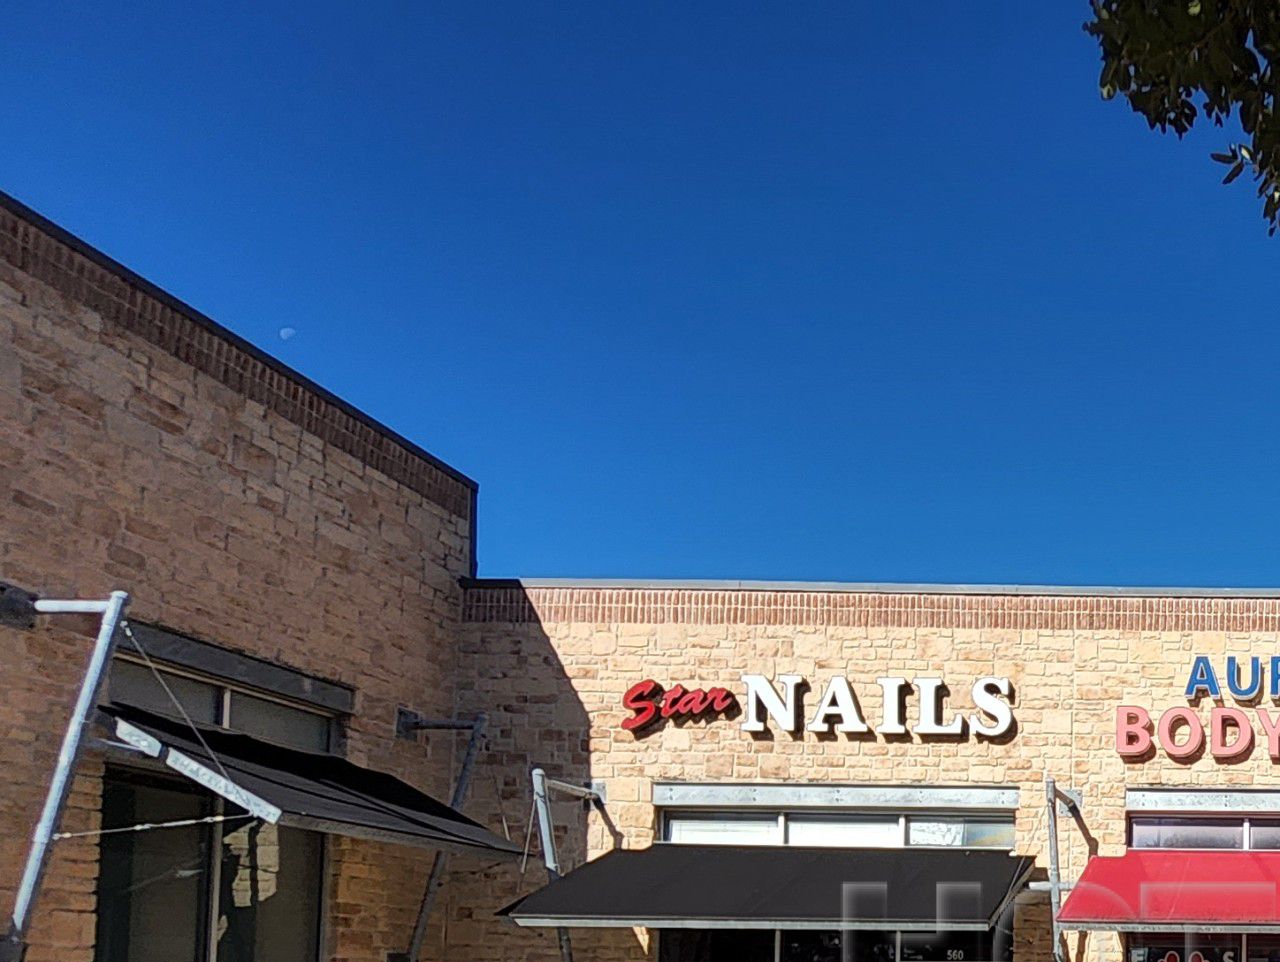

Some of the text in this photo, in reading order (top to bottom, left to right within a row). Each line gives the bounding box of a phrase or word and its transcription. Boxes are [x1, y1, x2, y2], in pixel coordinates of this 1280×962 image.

[620, 674, 1014, 737] Star NAILS
[946, 949, 964, 960] 560
